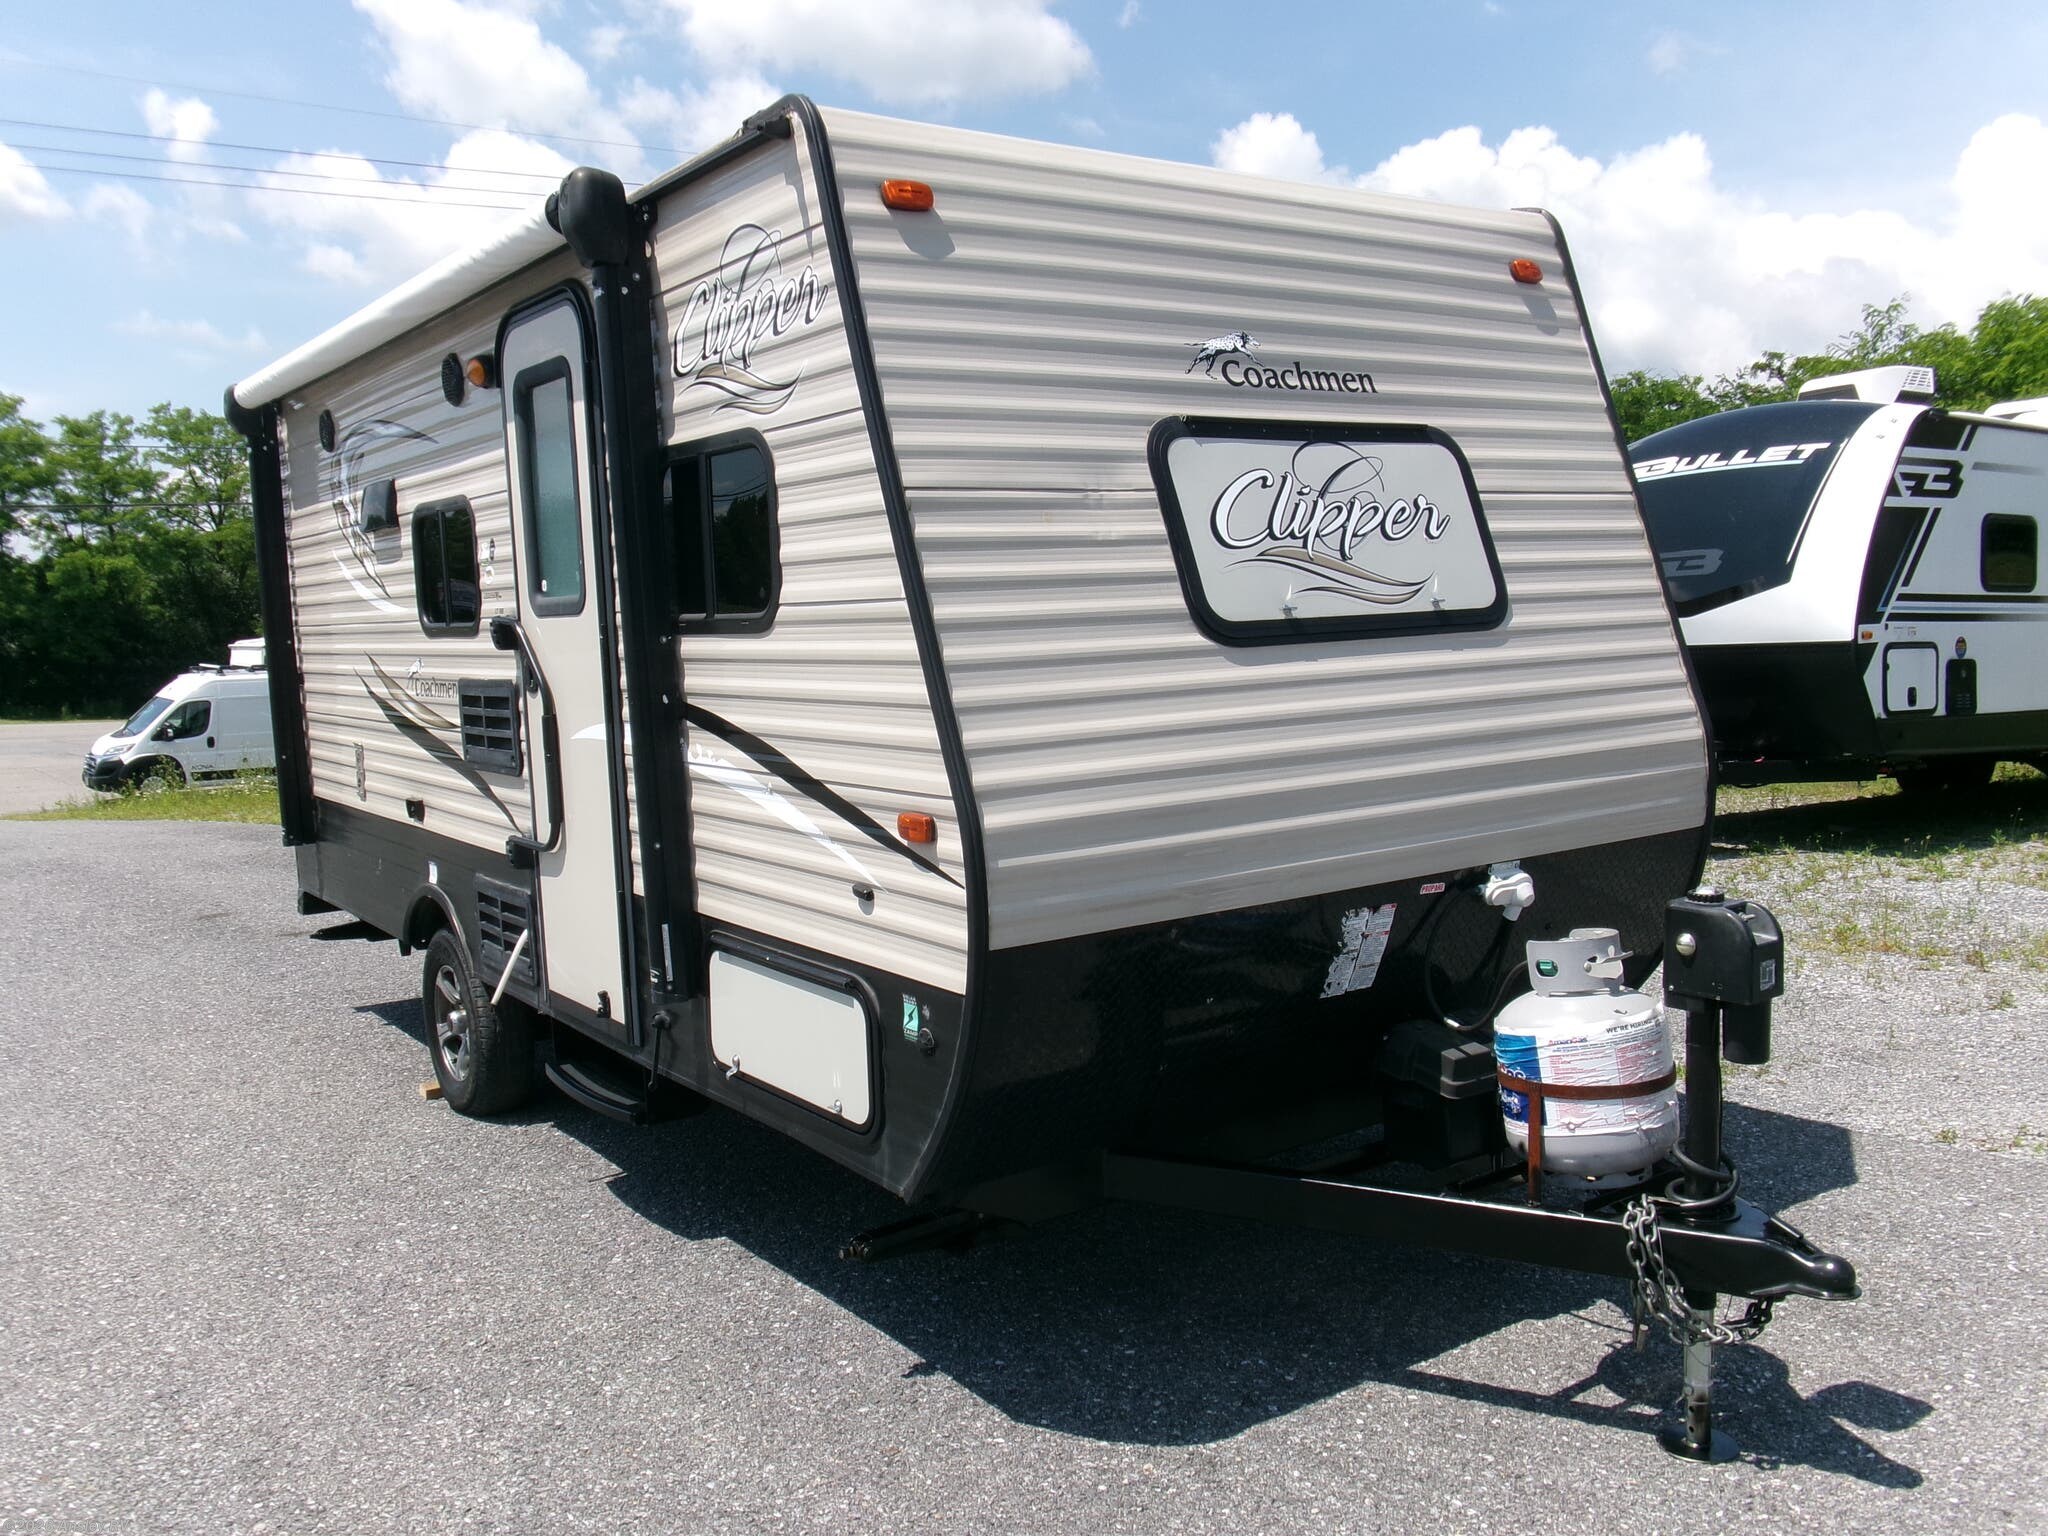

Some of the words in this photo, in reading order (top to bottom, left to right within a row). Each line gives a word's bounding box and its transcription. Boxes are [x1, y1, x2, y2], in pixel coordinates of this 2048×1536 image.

[674, 223, 828, 378] Clipper
[1221, 359, 1378, 394] Coachmen
[1632, 442, 1831, 479] BULLET
[1210, 441, 1450, 560] Clipper
[415, 677, 458, 699] Coachmen
